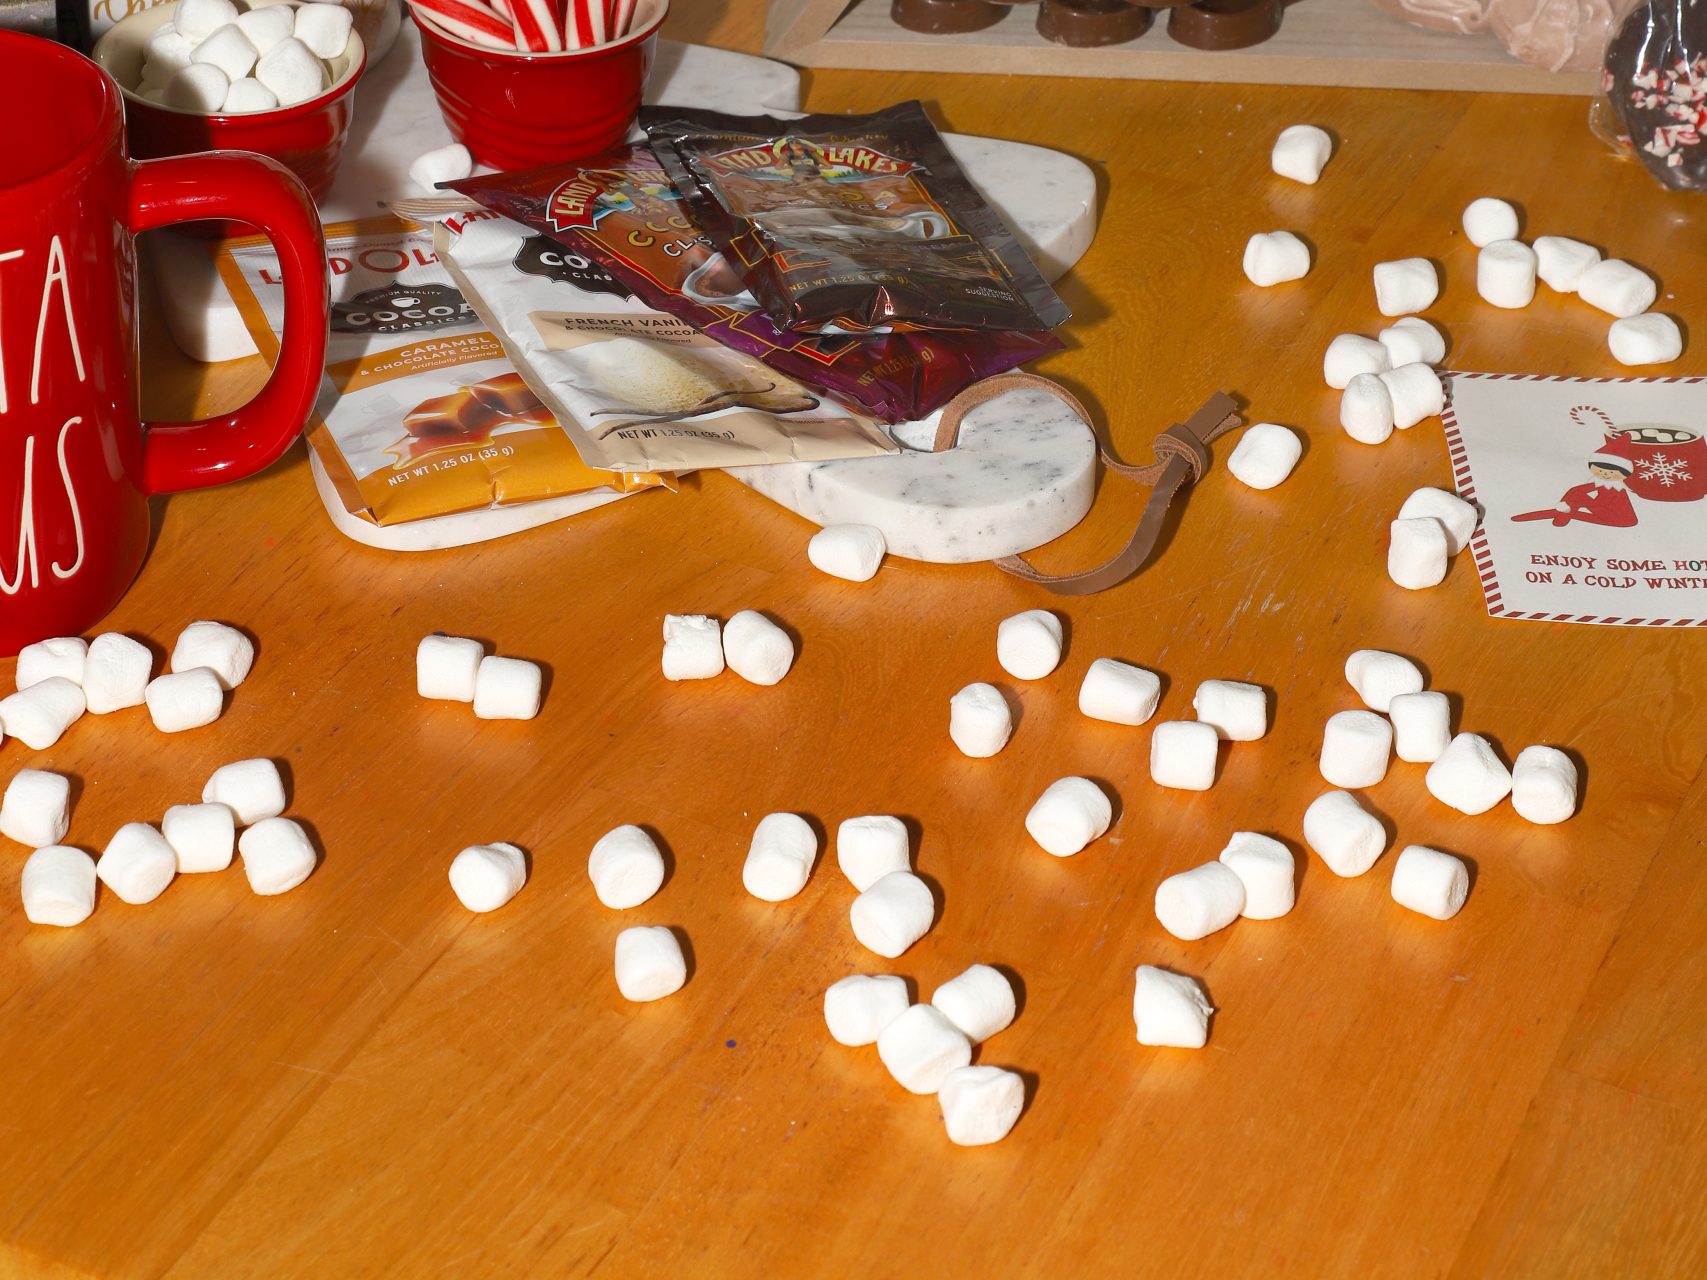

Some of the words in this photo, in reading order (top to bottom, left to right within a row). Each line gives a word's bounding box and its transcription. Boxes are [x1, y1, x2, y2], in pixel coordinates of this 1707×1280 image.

[828, 146, 899, 173] LAKES
[554, 181, 597, 215] LAND
[788, 281, 809, 293] NET
[812, 278, 829, 287] WT
[968, 286, 1012, 297] SERVING
[964, 288, 1015, 302] SUGGESTION
[377, 315, 467, 332] CLASSICS
[564, 318, 634, 327] FRENCH
[400, 337, 491, 358] CARAMEL
[373, 349, 457, 372] CHOCOLATE
[461, 343, 504, 353] COCO
[411, 356, 458, 370] Artificially
[459, 350, 498, 361] Flavored
[617, 429, 639, 439] NET
[643, 429, 658, 438] WT
[661, 428, 684, 437] 1.25
[388, 471, 411, 486] NET
[413, 465, 431, 477] WT
[432, 459, 457, 471] 1.25
[460, 453, 476, 464] OZ
[478, 448, 498, 460] (35
[501, 445, 515, 457] g)
[1530, 554, 1598, 570] ENJOY
[1606, 559, 1666, 572] SOME
[1526, 571, 1553, 584] ON
[1562, 573, 1578, 585] A
[1584, 575, 1637, 589] COLD
